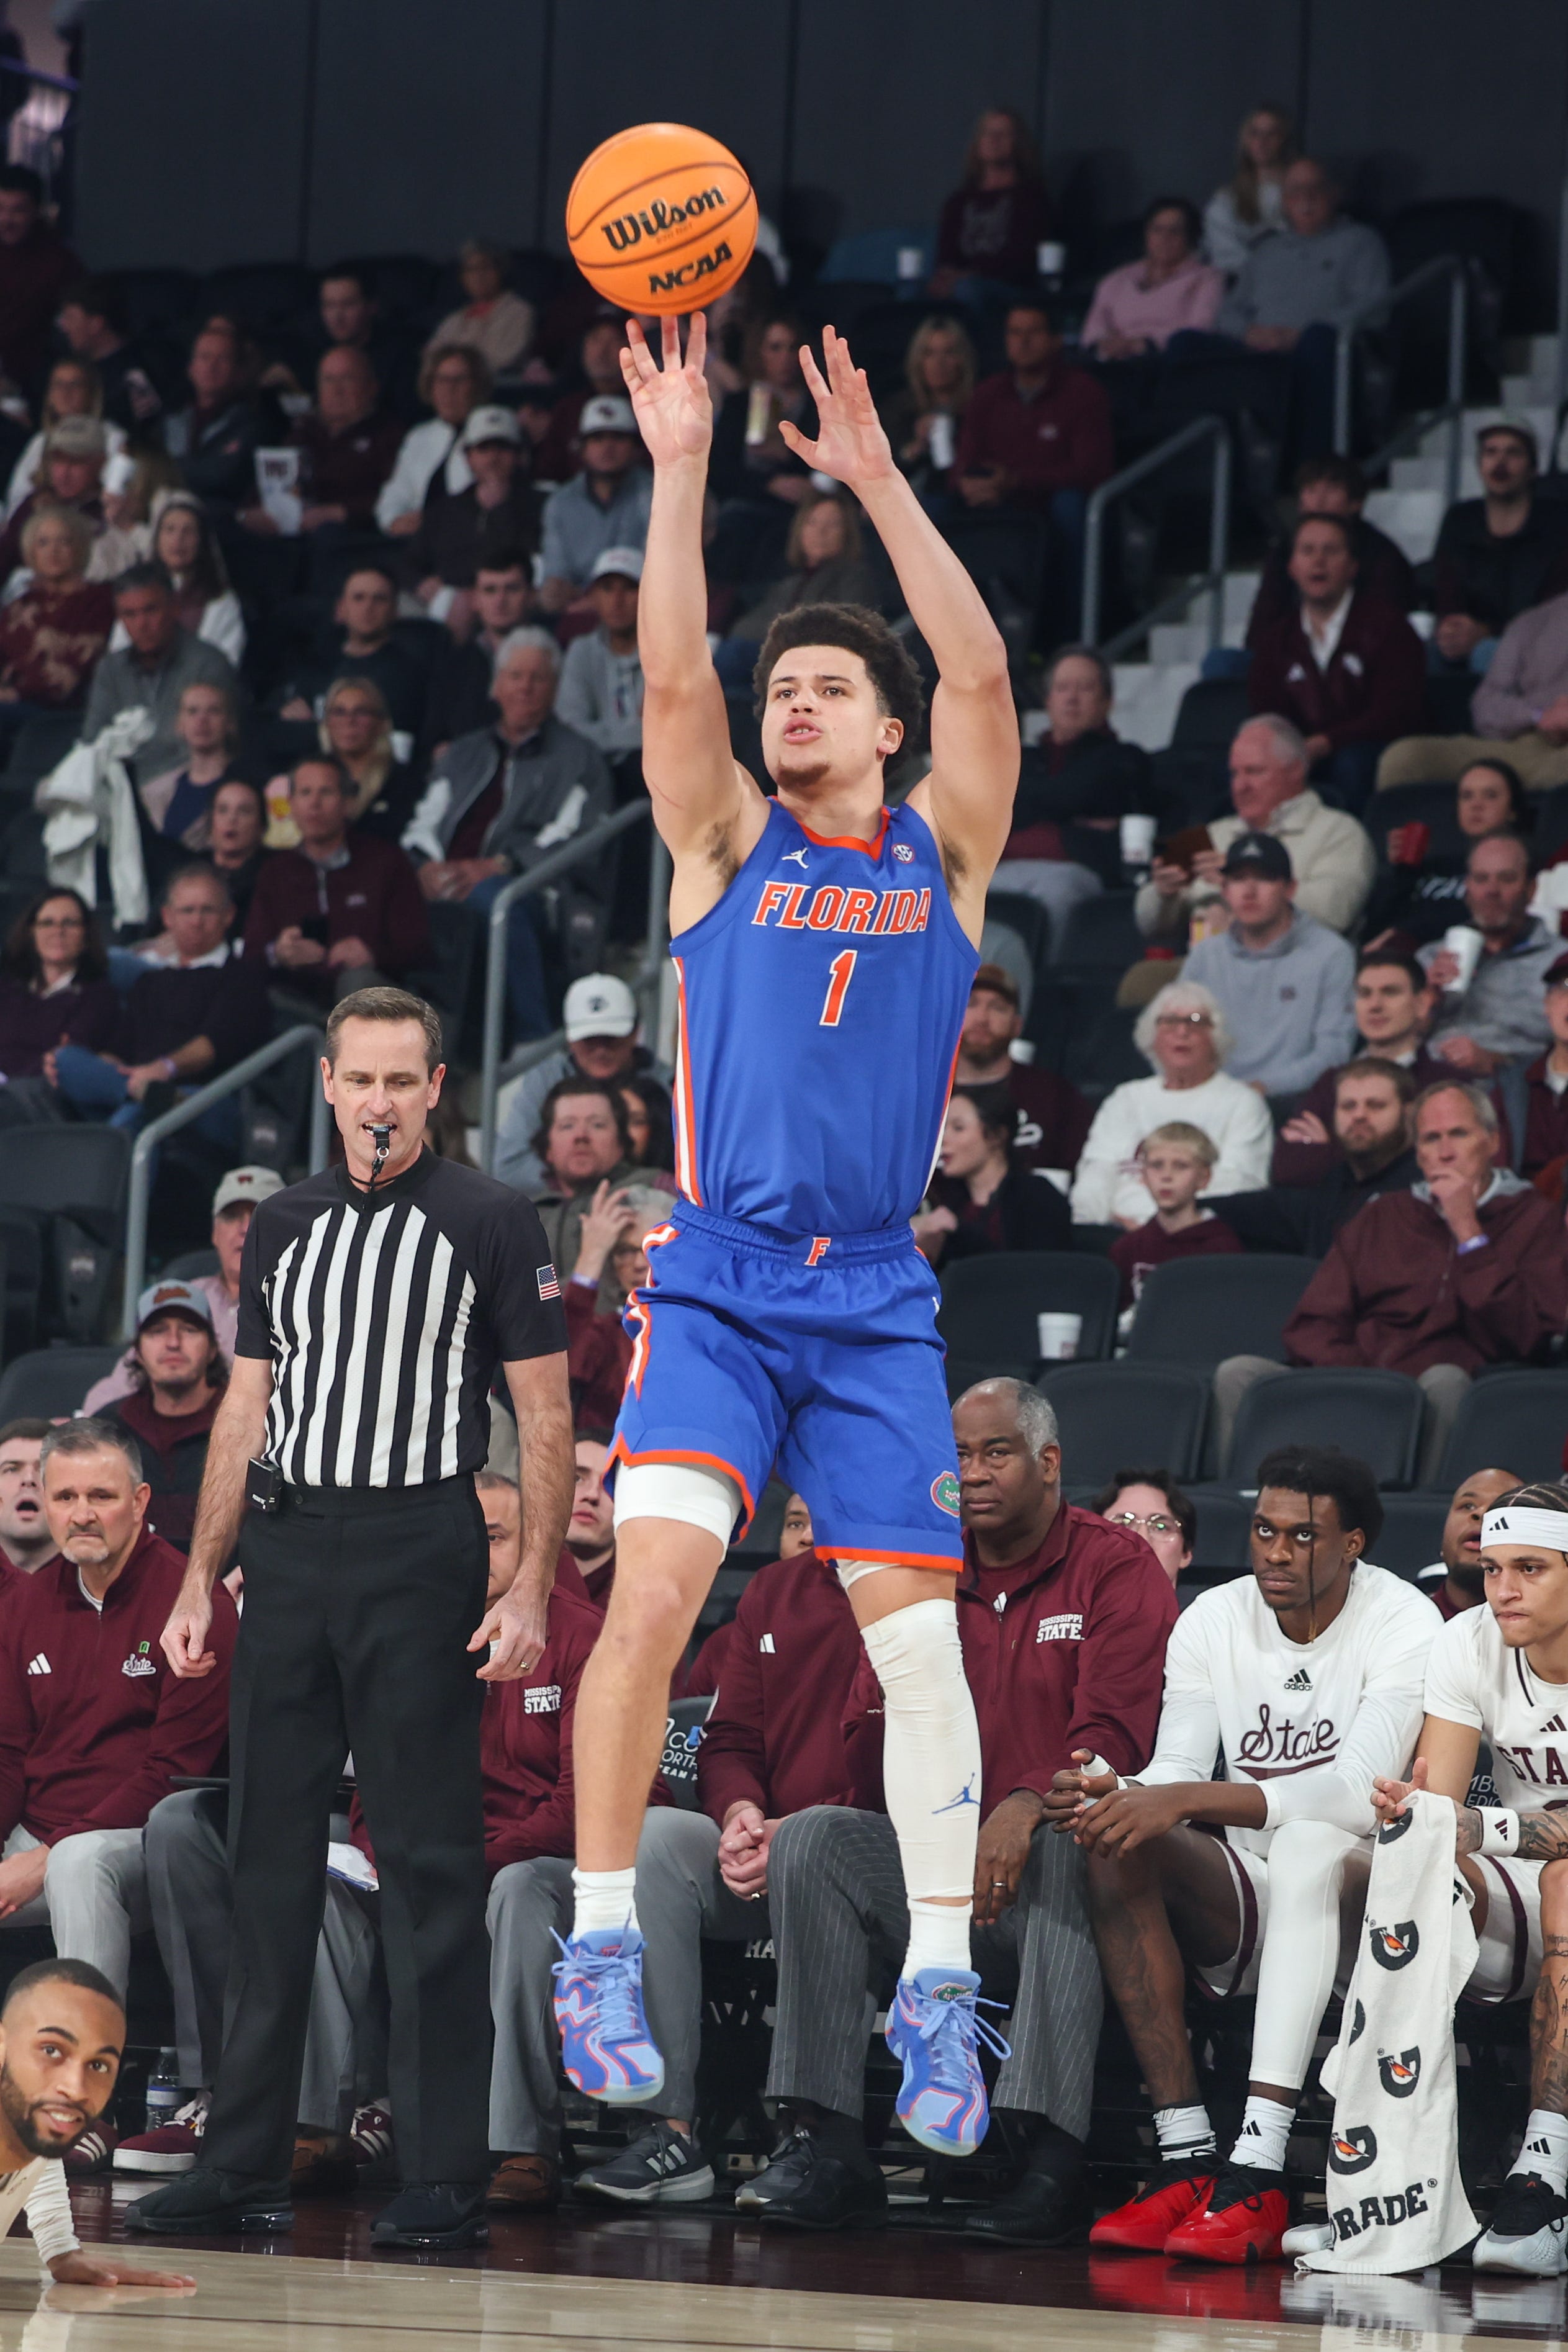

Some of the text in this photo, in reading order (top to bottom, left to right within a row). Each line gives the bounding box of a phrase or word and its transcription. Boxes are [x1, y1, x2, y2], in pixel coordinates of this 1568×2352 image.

[601, 186, 726, 251] Wilson
[649, 241, 732, 294] NCAA
[893, 844, 912, 862] SEC
[751, 880, 931, 935] FLORIDA
[819, 949, 858, 1027] 1
[804, 1237, 831, 1266] F
[1036, 1622, 1083, 1644] STATE
[1039, 1613, 1083, 1628] MISSISSIPPI
[122, 1653, 156, 1675] State
[1284, 1682, 1313, 1691] adidas
[1233, 1703, 1341, 1763] State
[1496, 1746, 1568, 1785] STA
[1330, 2182, 1429, 2245] RADE
